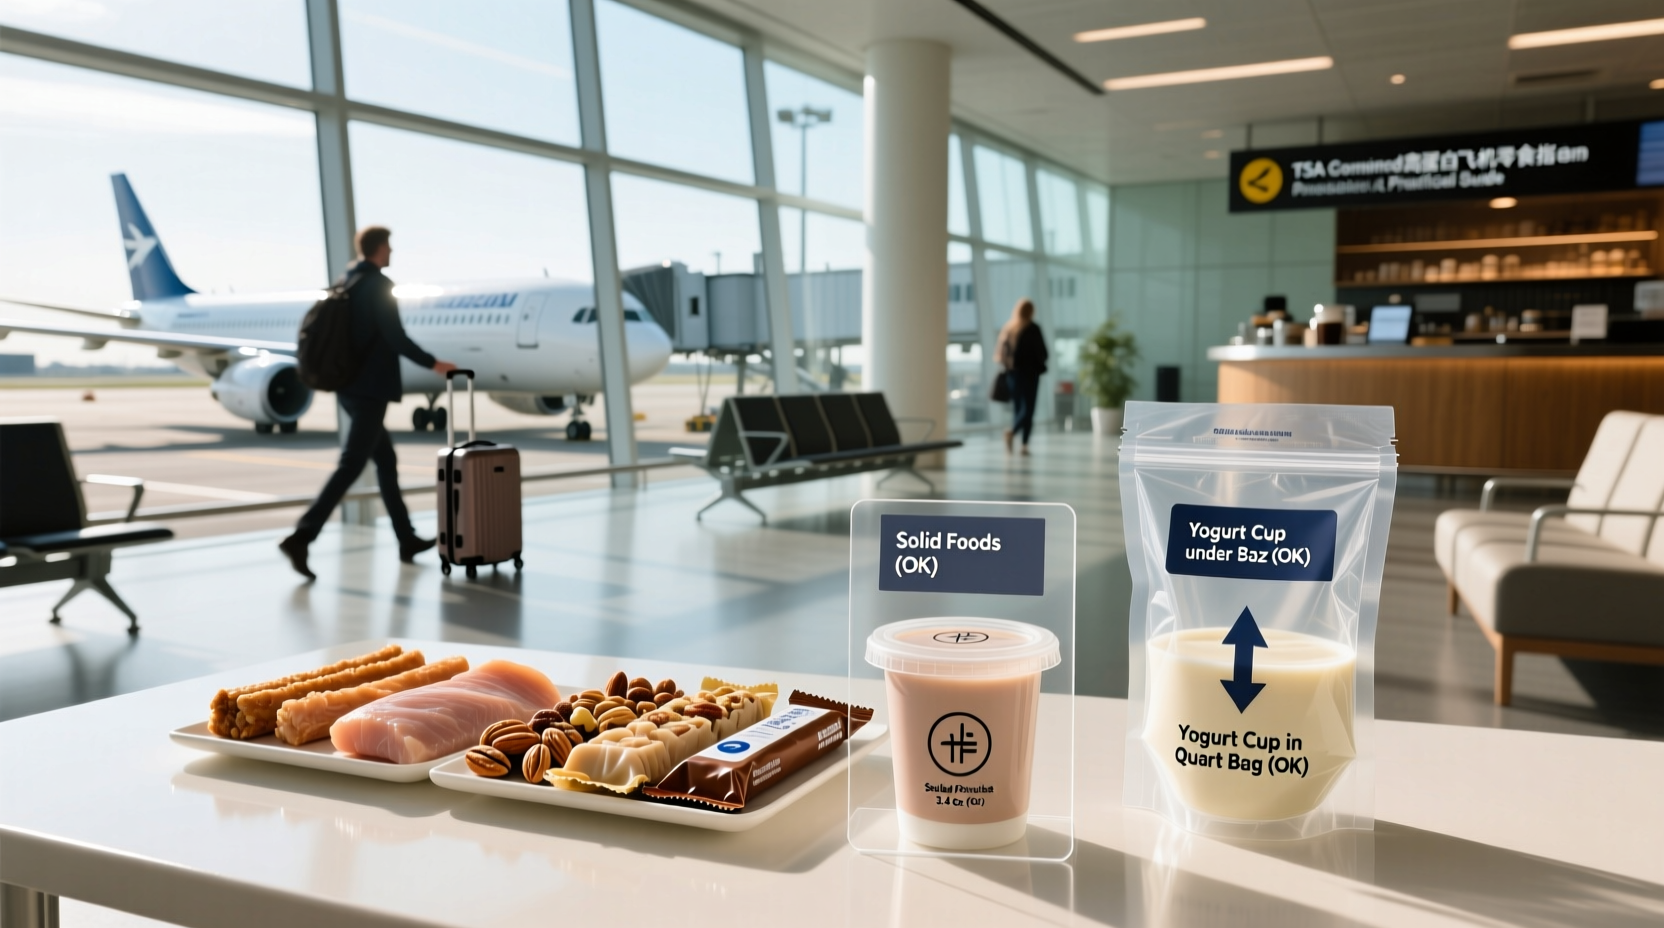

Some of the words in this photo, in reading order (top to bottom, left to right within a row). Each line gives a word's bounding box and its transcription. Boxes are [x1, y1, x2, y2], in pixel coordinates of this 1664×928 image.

[1291, 160, 1326, 179] TSA
[895, 531, 942, 550] Solid
[946, 532, 1002, 552] Foods
[1189, 521, 1246, 543] Yogurt
[1251, 524, 1287, 544] Cup
[895, 555, 939, 578] (OK)
[1185, 545, 1233, 562] under
[1237, 547, 1269, 563] Baz
[1272, 547, 1311, 568] (OK)
[1178, 724, 1238, 748] Yogurt
[1243, 731, 1281, 753] Cup
[1286, 733, 1303, 751] in
[1175, 747, 1223, 769] Quart
[1228, 753, 1263, 776] Bag
[1268, 755, 1309, 778] (OK)
